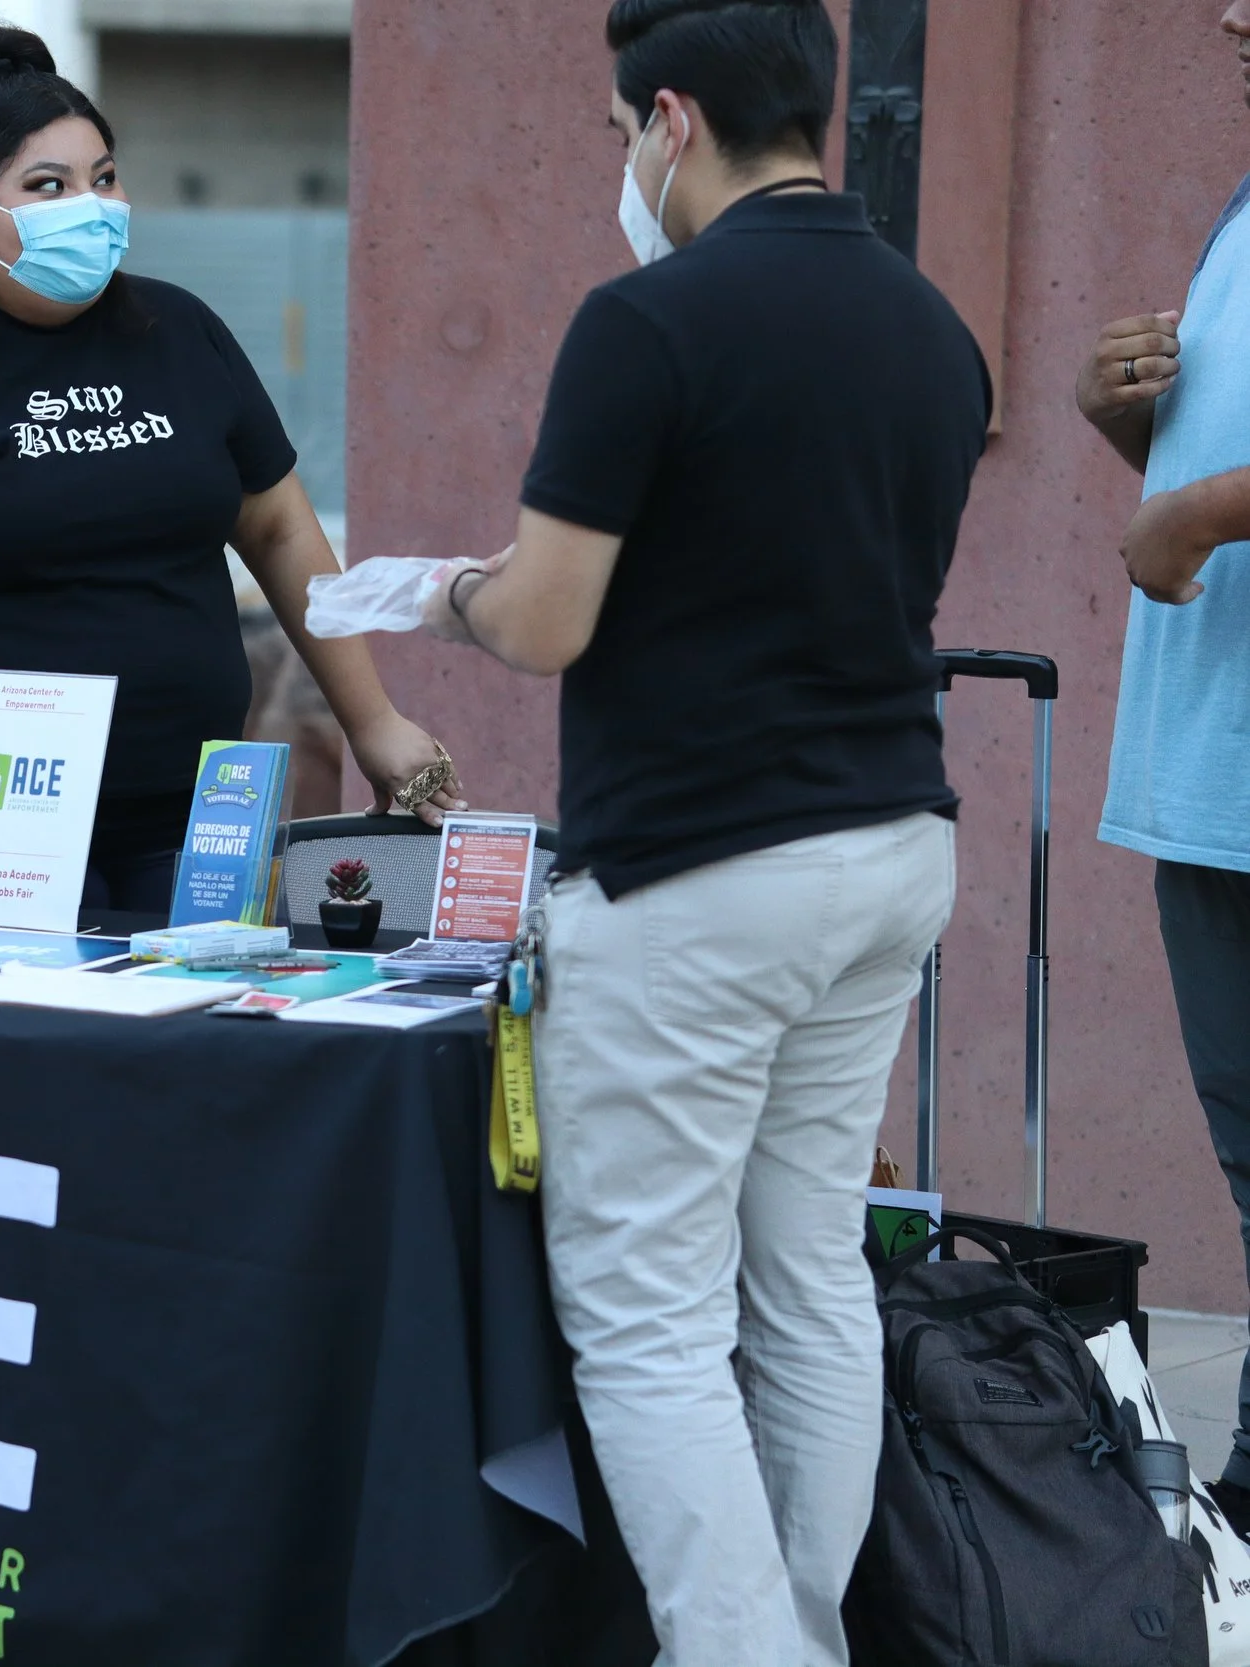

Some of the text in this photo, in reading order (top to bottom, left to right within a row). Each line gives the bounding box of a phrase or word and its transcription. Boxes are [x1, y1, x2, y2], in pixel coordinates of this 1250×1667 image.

[26, 384, 123, 421] Stay
[9, 411, 174, 459] Blessed
[1, 686, 64, 697] Arizona Center for
[5, 701, 55, 711] Empowerment
[10, 757, 66, 797] ACE
[230, 764, 252, 780] ACE
[194, 823, 251, 838] DERECHOS DE
[192, 836, 249, 856] VOTANTE
[9, 869, 50, 883] Academy
[191, 872, 236, 882] NO DEJE QUE
[188, 881, 236, 891] NADA LO PARE
[16, 888, 34, 899] Fair
[192, 890, 203, 898] DE
[218, 892, 229, 900] UN
[1228, 1576, 1250, 1598] Are
